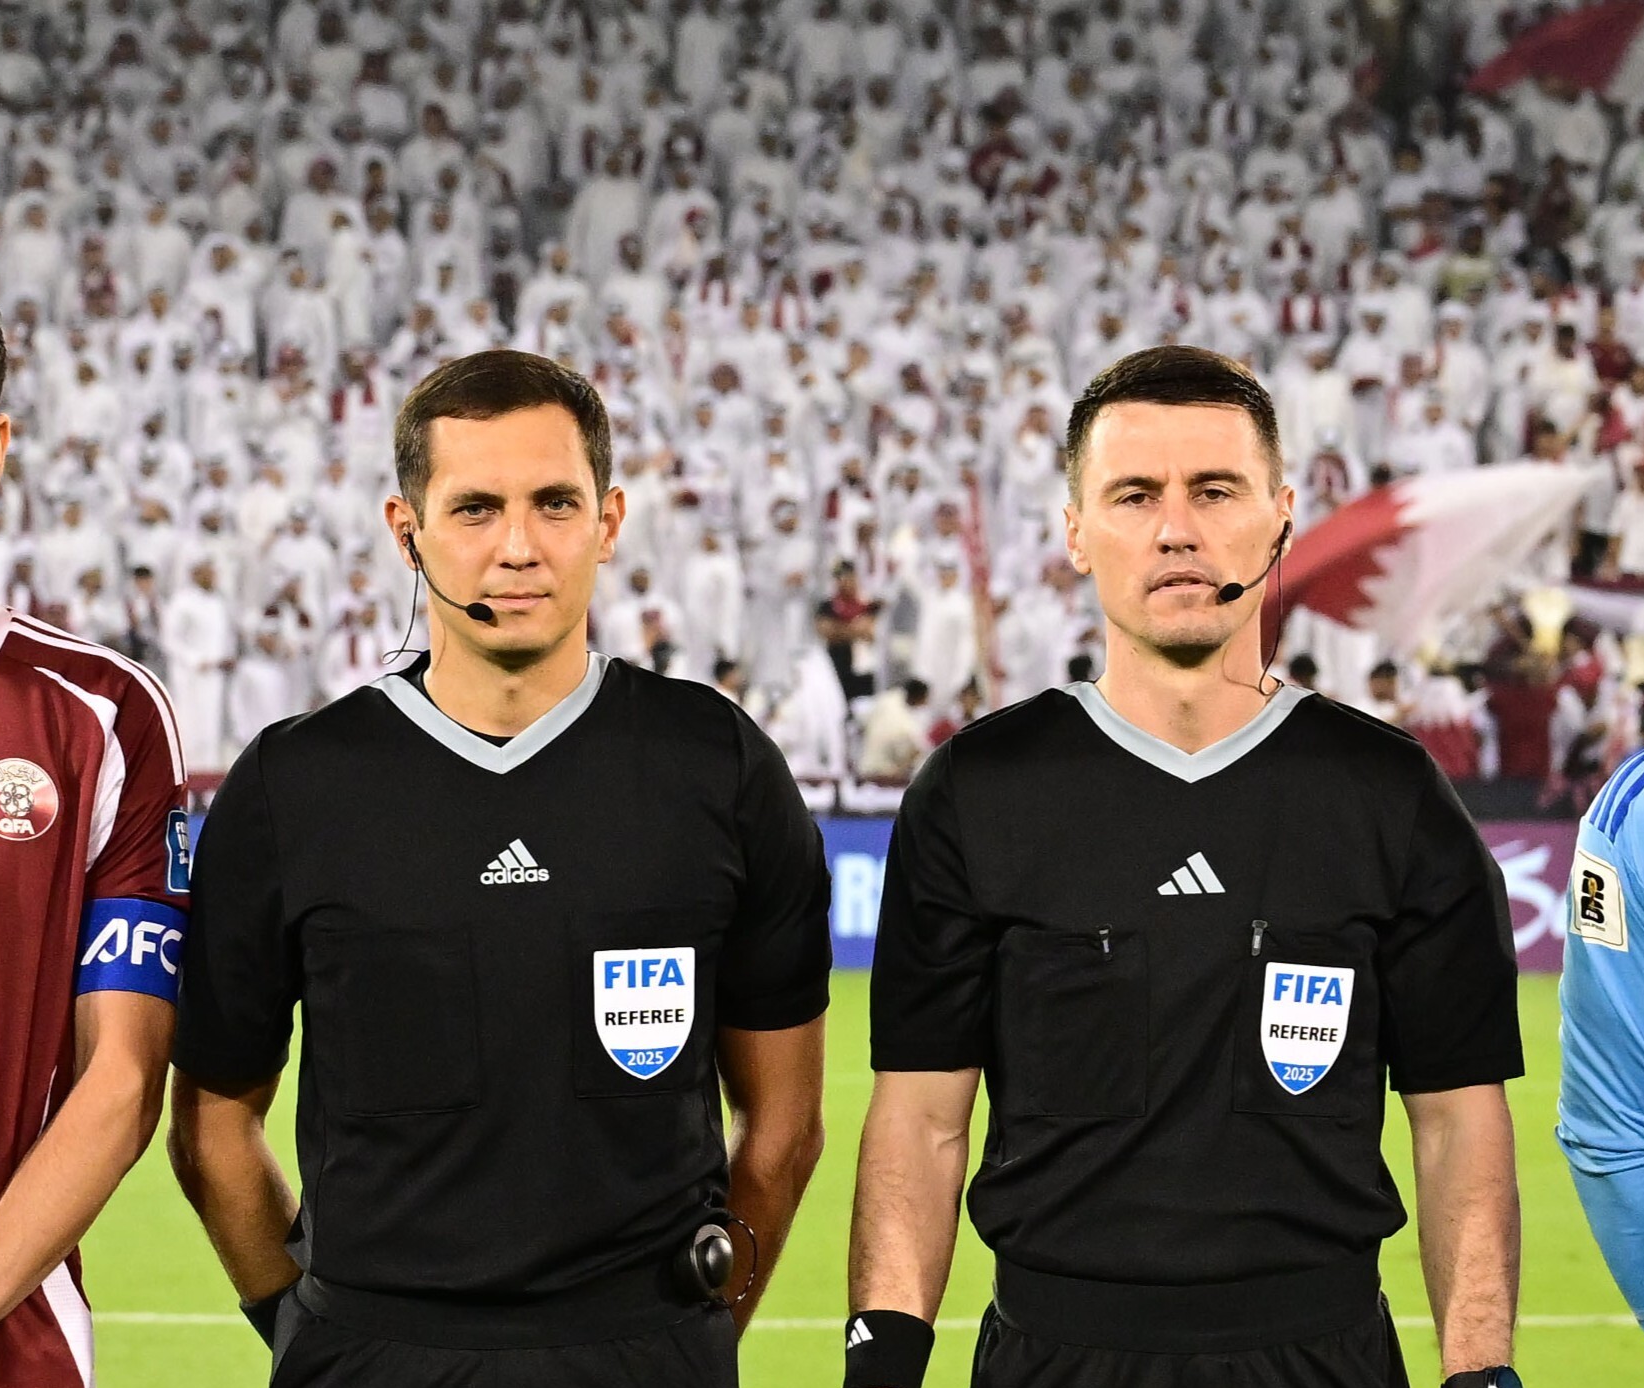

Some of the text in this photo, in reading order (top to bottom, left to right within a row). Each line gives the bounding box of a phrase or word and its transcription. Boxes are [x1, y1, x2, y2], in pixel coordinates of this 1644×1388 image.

[480, 866, 550, 885] adidas
[80, 917, 183, 976] AFC
[604, 958, 685, 989] FIFA
[1273, 973, 1343, 1006] FIFA
[604, 1008, 685, 1026] REFEREE
[1269, 1023, 1339, 1042] REFEREE
[627, 1051, 664, 1066] 2025
[1282, 1066, 1315, 1082] 2025
